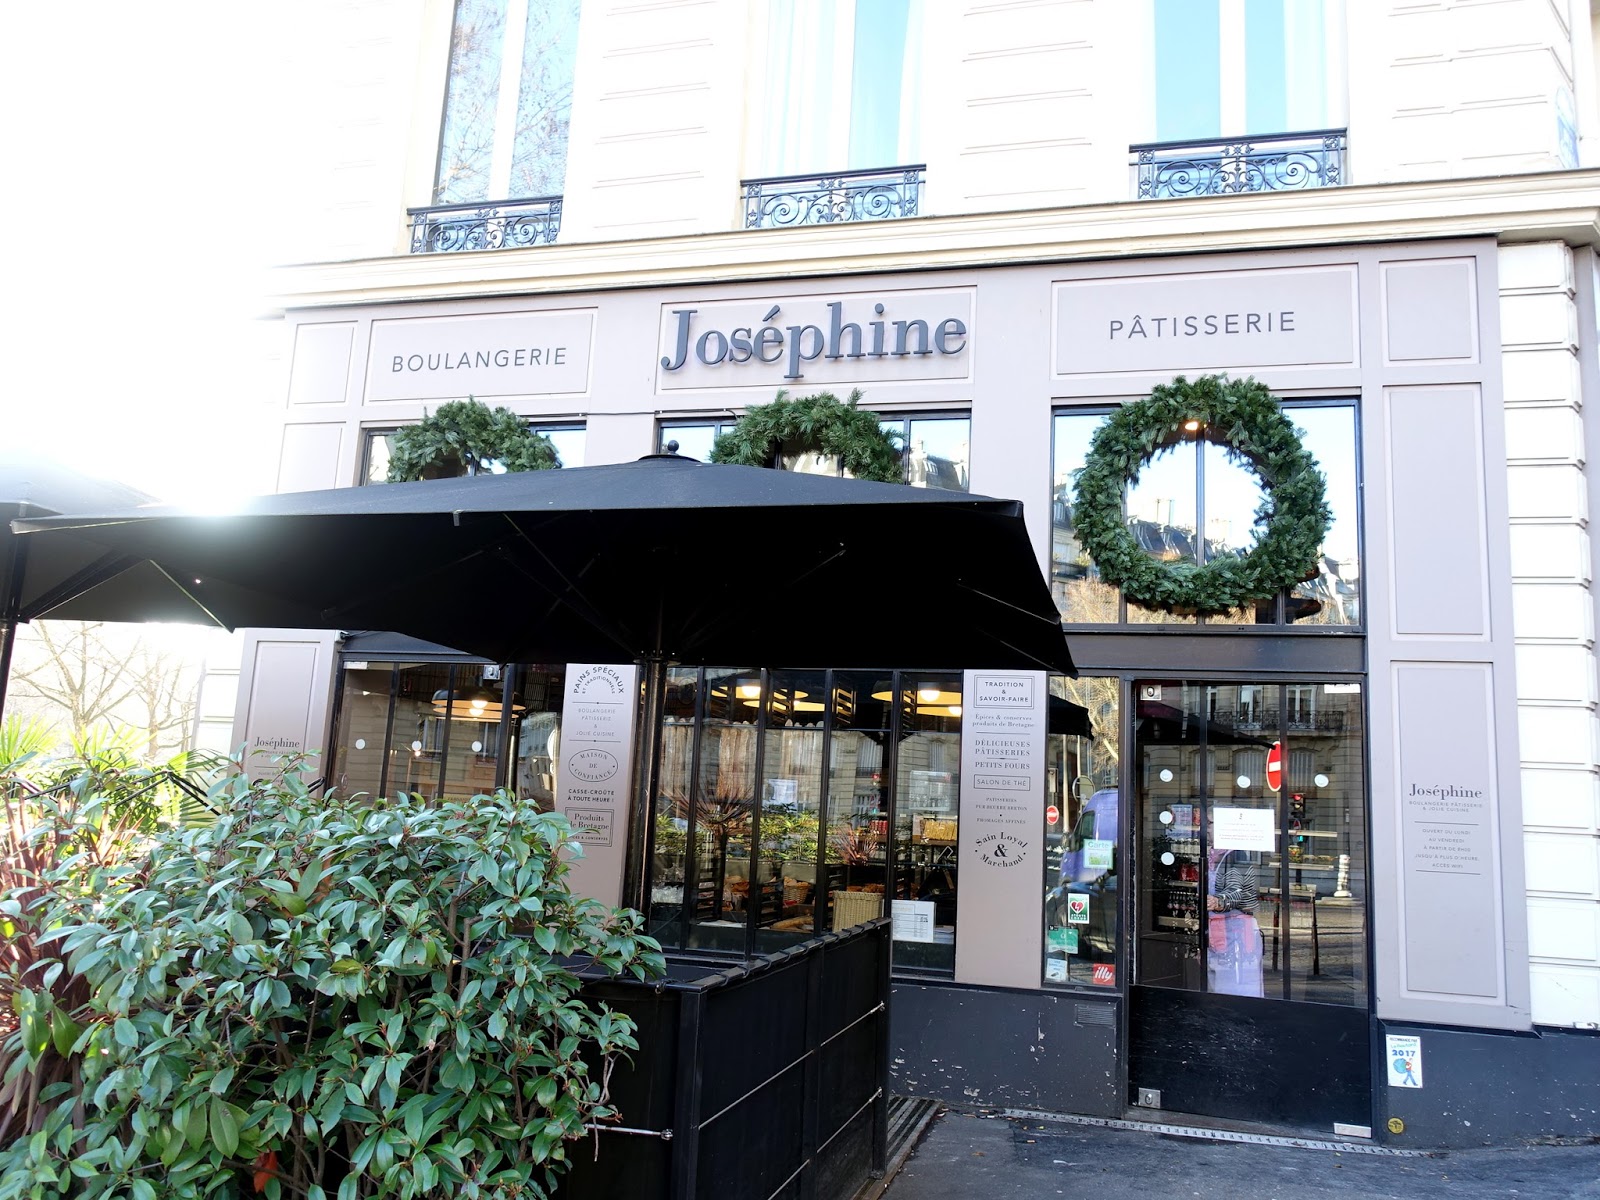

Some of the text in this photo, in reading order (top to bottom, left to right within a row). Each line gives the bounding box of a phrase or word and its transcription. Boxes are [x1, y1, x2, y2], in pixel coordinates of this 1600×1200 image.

[1110, 311, 1295, 339] PÂTISSERIE
[661, 301, 967, 379] Joséphine
[391, 347, 567, 373] BOULANGERIE
[574, 666, 624, 694] PAINS SPÉCIAUX
[254, 736, 300, 750] Joséphine
[975, 739, 1031, 748] DÉLICIEUSES
[580, 752, 608, 760] MAISON
[975, 747, 1031, 757] PÂTISSERIES
[975, 761, 1030, 770] PETITS FOURS
[574, 768, 612, 780] CONFIANCE
[977, 778, 1000, 786] SALON
[568, 788, 615, 796] CASSE-CROÛTE
[1409, 783, 1482, 801] Joséphine
[574, 813, 605, 822] Produits
[578, 821, 610, 830] Bretagne
[976, 831, 1028, 848] Sain Loyal
[994, 843, 1009, 857] &
[980, 853, 1024, 868] Marchand
[1094, 966, 1113, 982] illy
[1392, 1049, 1416, 1057] 2017
